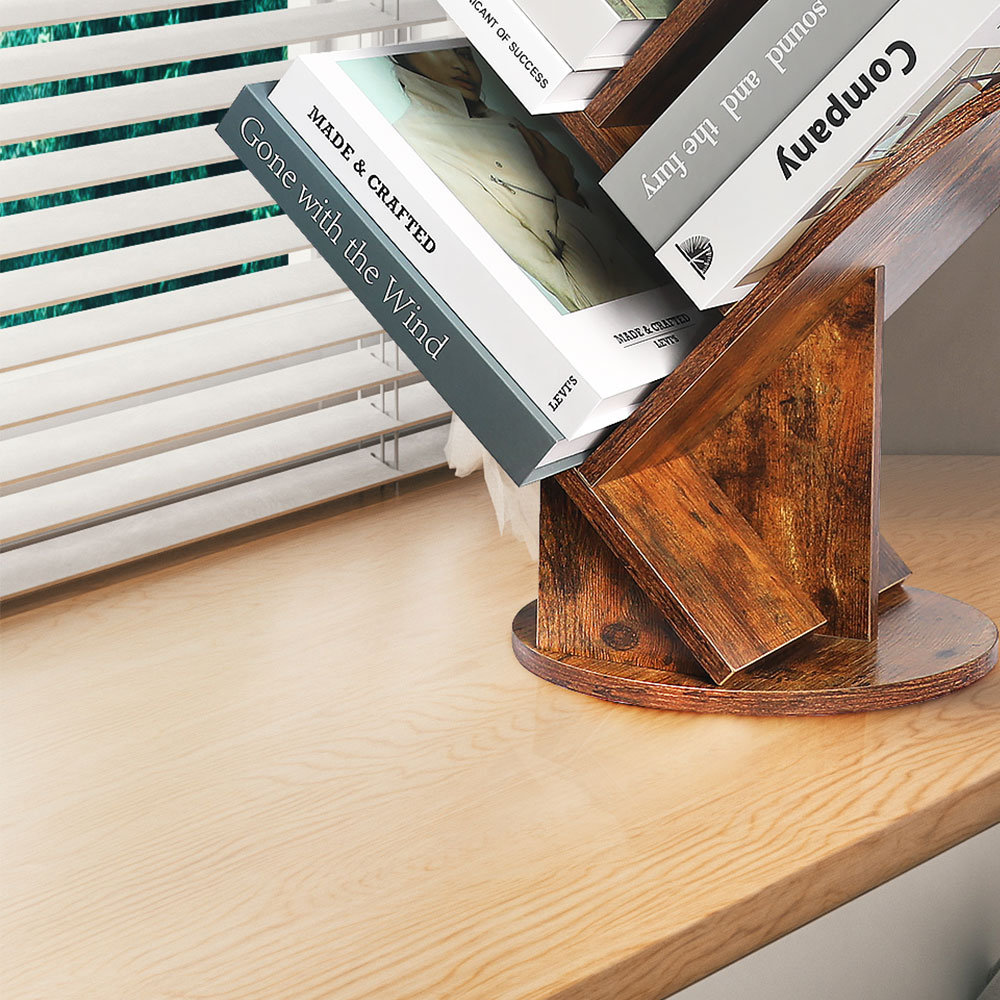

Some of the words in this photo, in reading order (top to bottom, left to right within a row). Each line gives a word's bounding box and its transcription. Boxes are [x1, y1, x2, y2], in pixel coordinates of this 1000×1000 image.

[496, 27, 511, 42] OF
[508, 42, 549, 89] SUCCESS
[765, 0, 828, 75] sound
[719, 70, 761, 122] and
[777, 40, 917, 180] Company
[682, 118, 720, 155] the
[307, 105, 355, 161] MADE
[353, 159, 366, 177] &
[367, 174, 437, 254] CRAFTED
[641, 152, 688, 200] fury
[240, 117, 297, 189] Gone
[297, 184, 345, 246] with
[343, 238, 380, 285] the
[382, 275, 449, 361] Wind
[613, 326, 645, 344] MADE
[642, 325, 653, 335] &
[652, 313, 691, 332] CRAFTED
[653, 334, 680, 349] LEVI'S
[548, 375, 578, 412] LEVI'S
